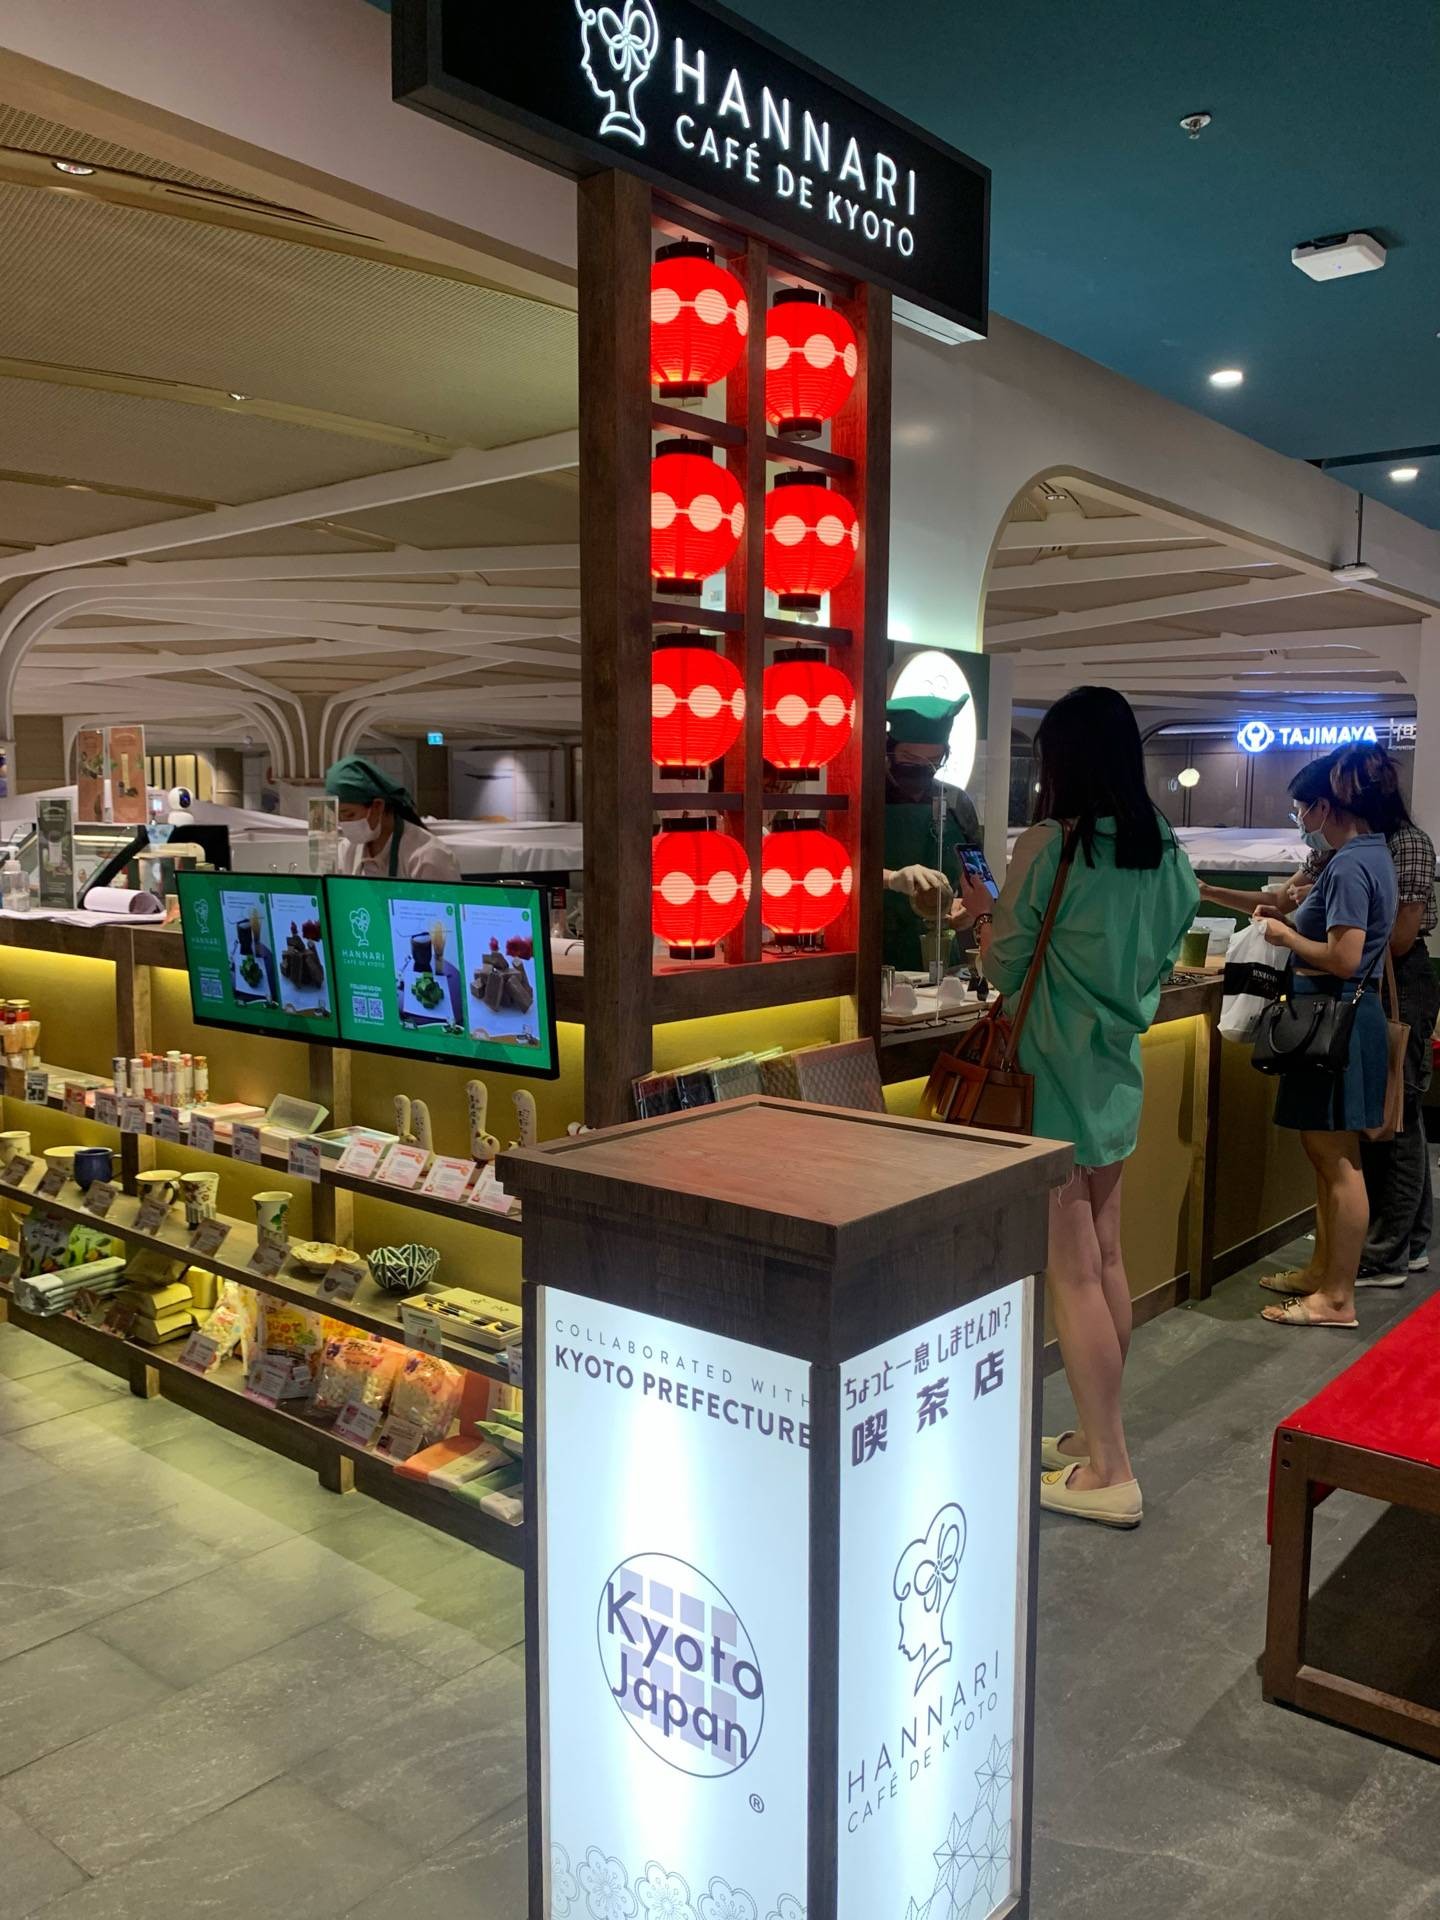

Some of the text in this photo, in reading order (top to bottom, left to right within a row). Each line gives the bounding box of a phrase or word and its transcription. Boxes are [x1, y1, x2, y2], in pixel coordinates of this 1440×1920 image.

[675, 37, 916, 216] HANNARI
[675, 114, 915, 257] CAFÉ DE KYOTO
[1278, 725, 1379, 746] TAJIMAYA
[341, 949, 386, 961] HANNARI
[555, 1319, 733, 1384] COLLABORATED
[555, 1344, 812, 1450] KYOTO PREFECTURE
[607, 1581, 764, 1701] Kyoto
[611, 1651, 748, 1760] Japan
[847, 1691, 998, 1834] CAFÉ DE KYOTO
[848, 1650, 998, 1804] HANNARI
